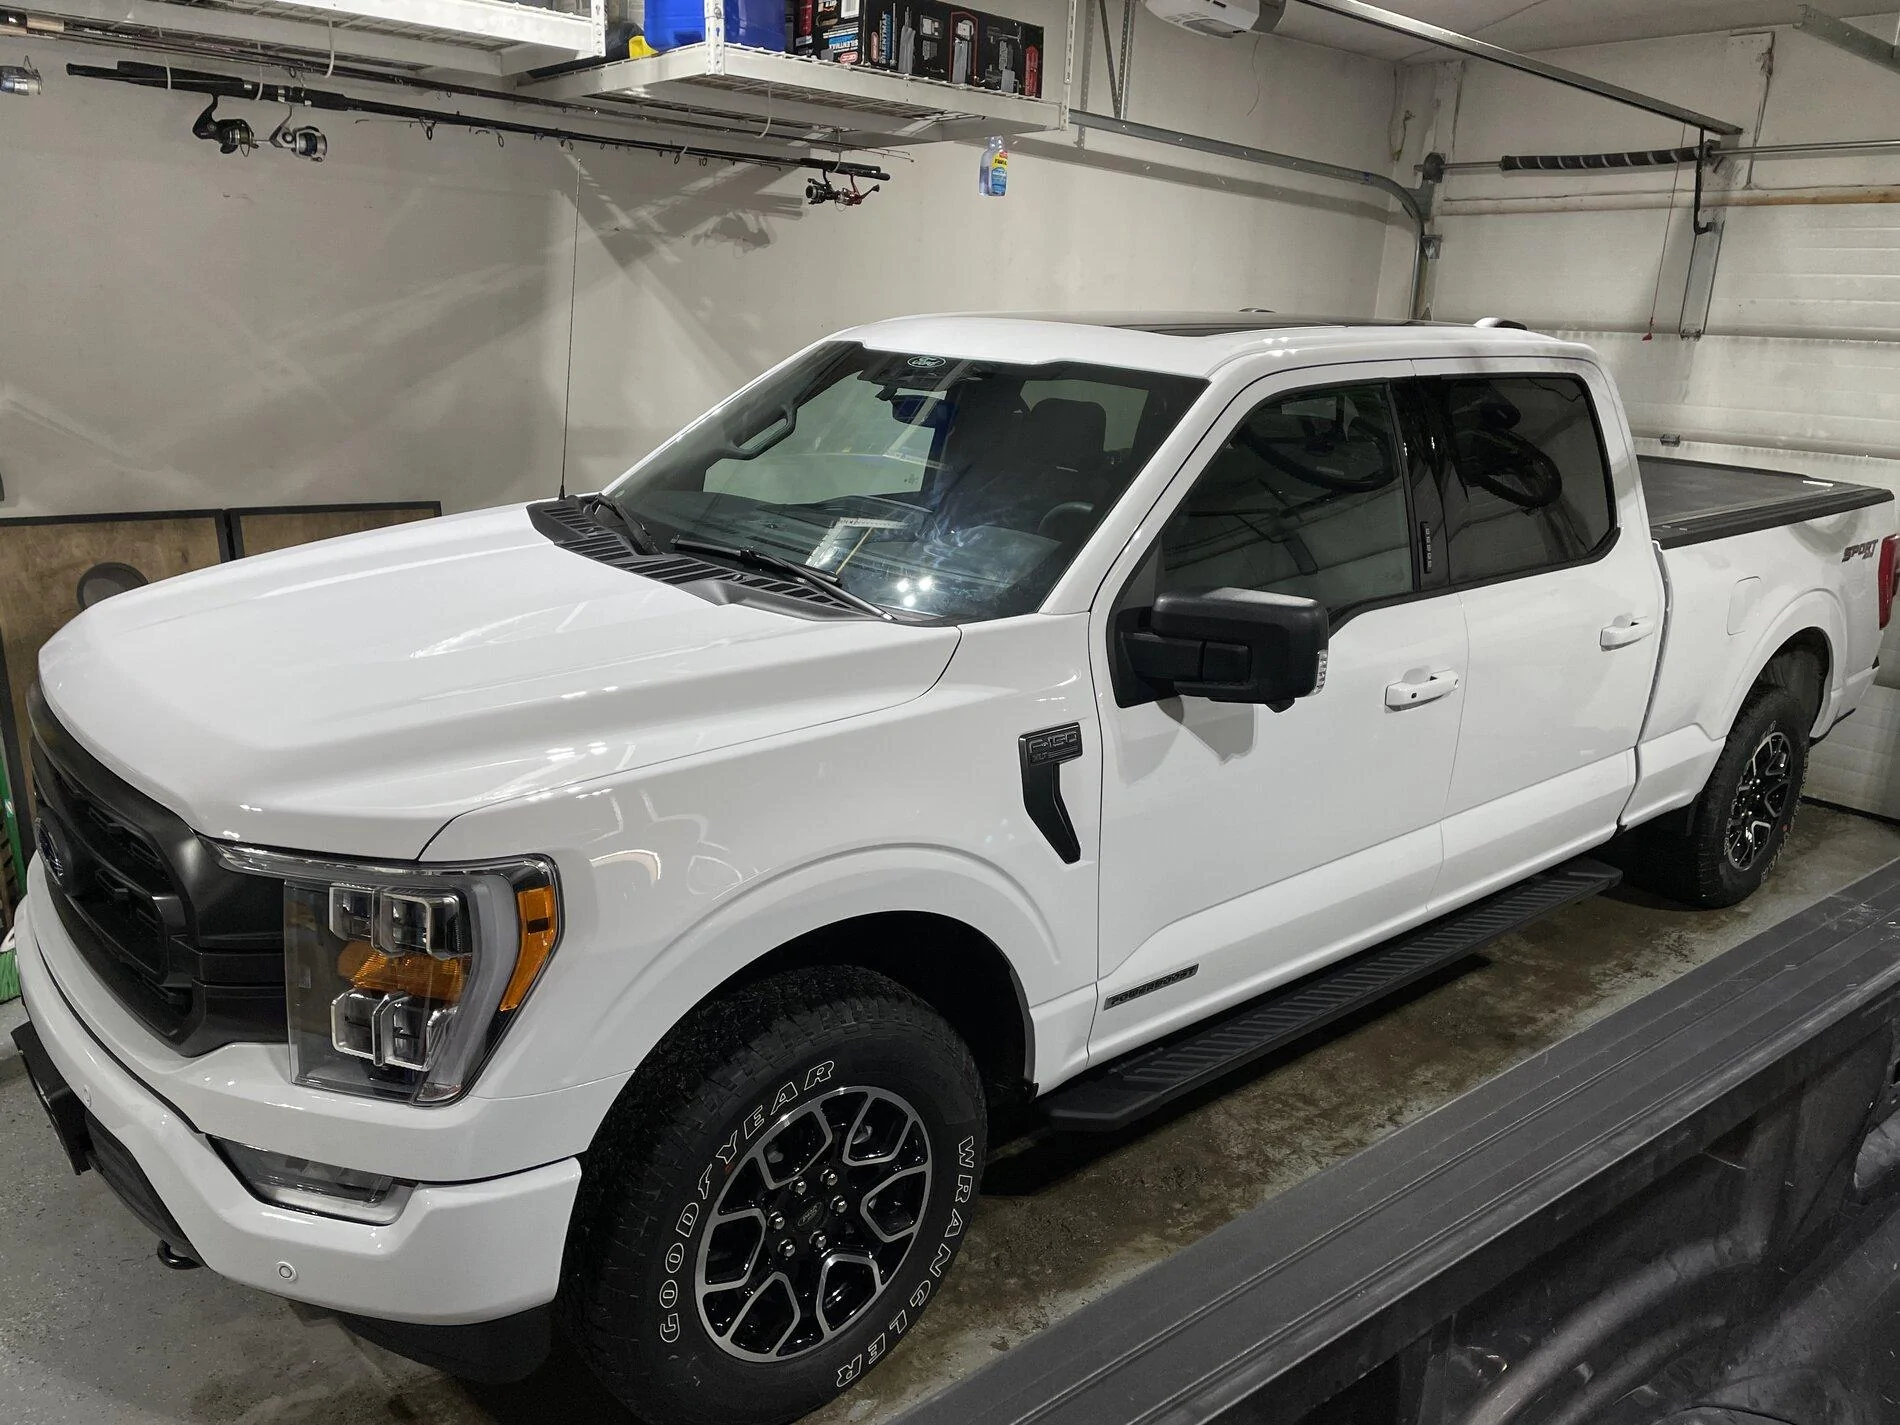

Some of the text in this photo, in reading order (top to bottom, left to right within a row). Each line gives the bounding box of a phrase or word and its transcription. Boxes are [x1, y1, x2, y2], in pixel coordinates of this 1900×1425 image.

[1029, 731, 1078, 754] F-150
[660, 1061, 834, 1342] GOODYEAR
[836, 1136, 975, 1387] WRANGLER
